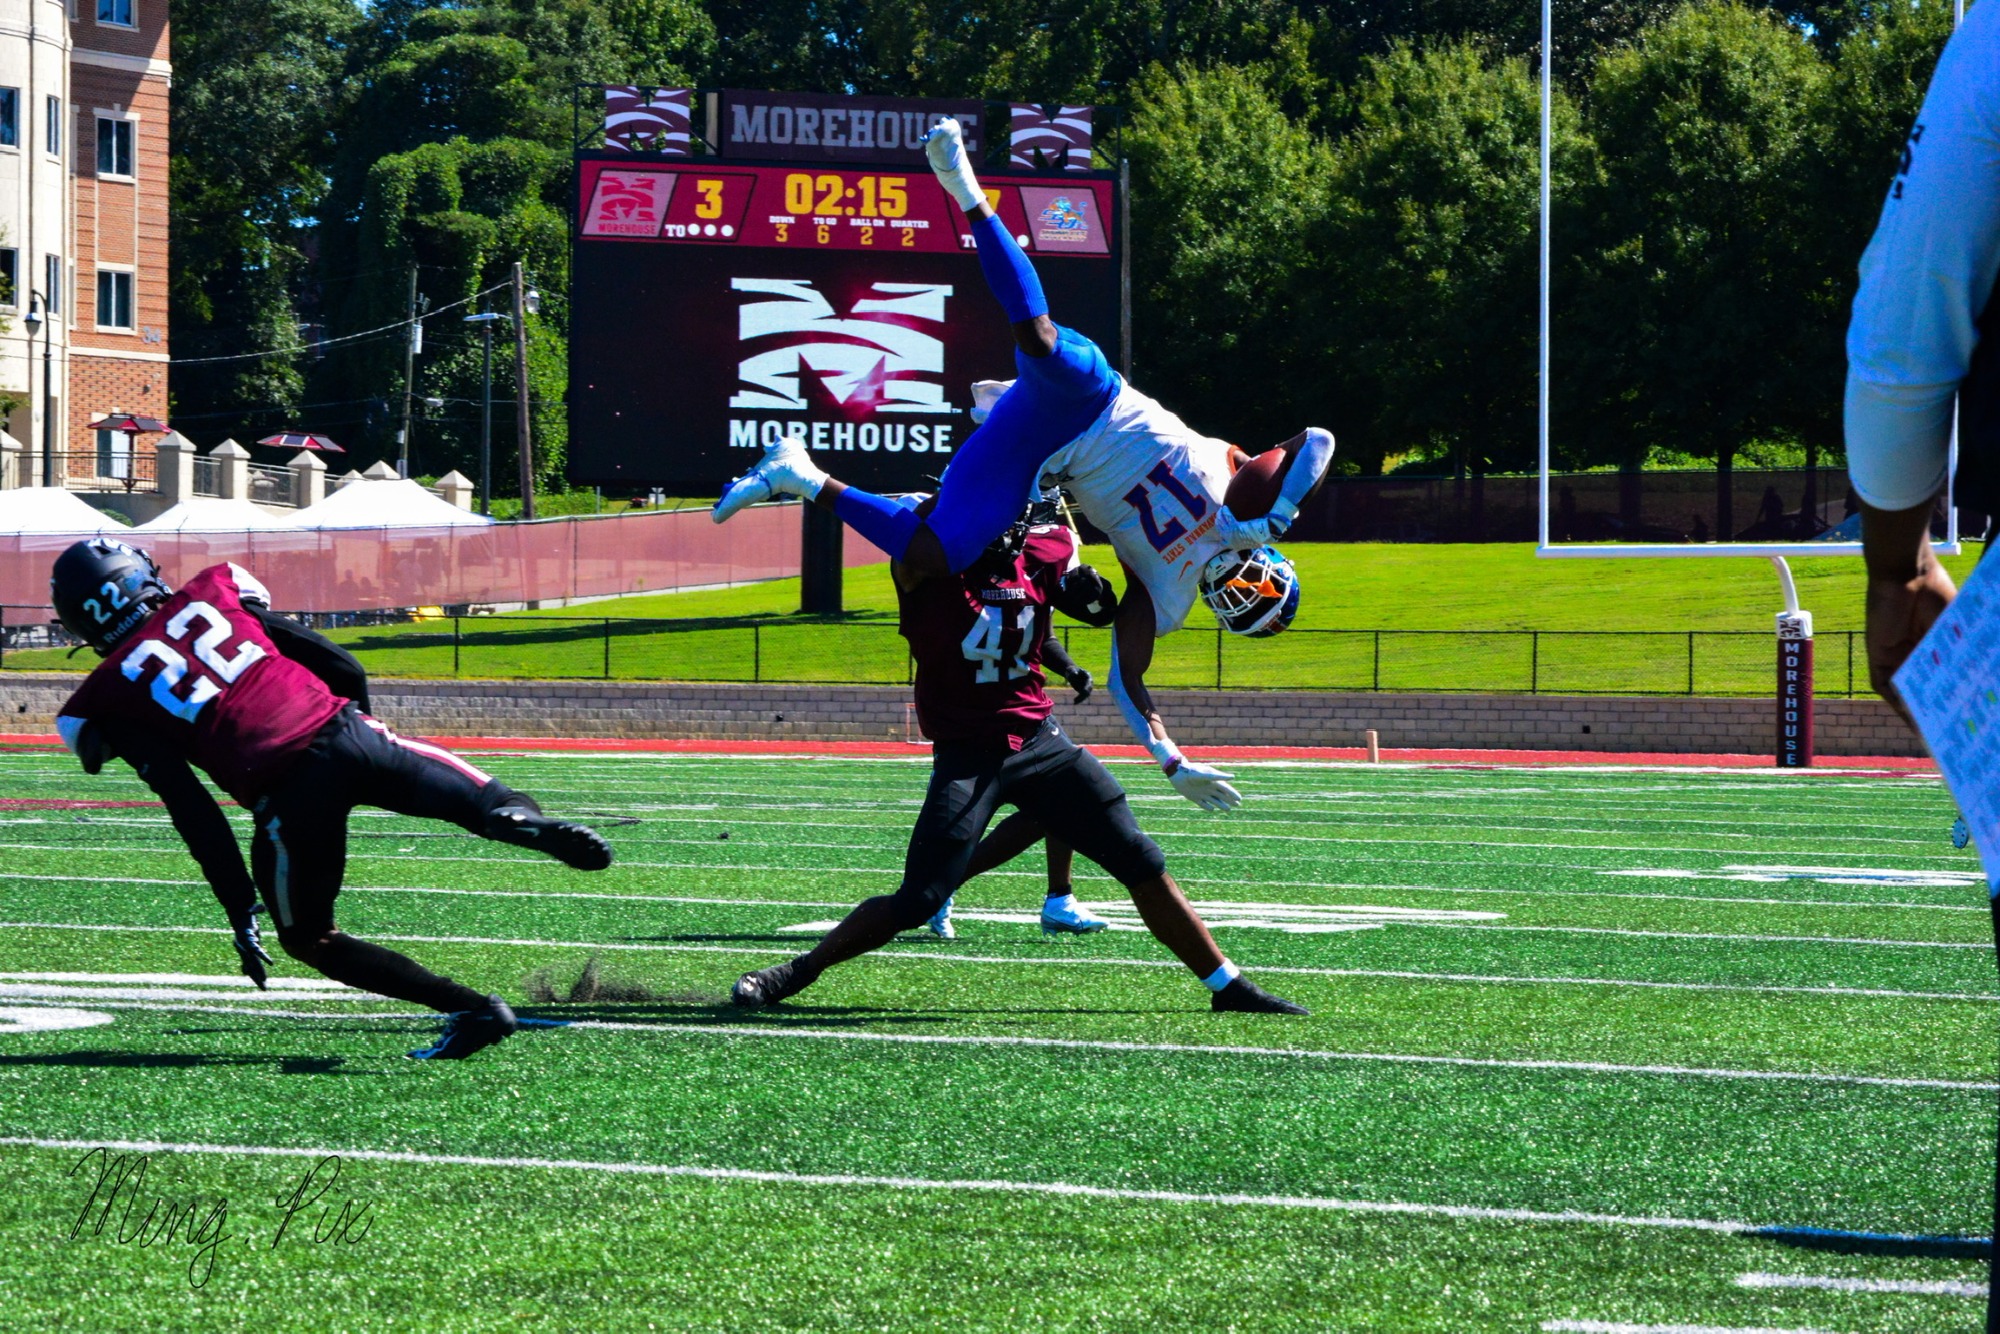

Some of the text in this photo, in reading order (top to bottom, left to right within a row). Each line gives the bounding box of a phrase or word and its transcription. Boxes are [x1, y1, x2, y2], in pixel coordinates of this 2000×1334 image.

[731, 104, 977, 151] MOREHOUE
[695, 179, 724, 219] 3
[785, 173, 908, 218] 02:15
[665, 224, 686, 237] TO
[775, 223, 788, 243] 3
[817, 224, 830, 244] 6
[860, 226, 873, 245] 2
[901, 227, 915, 247] 2
[729, 419, 953, 453] MOREHOUSE
[1122, 459, 1207, 555] 17
[83, 581, 130, 625] 22
[103, 601, 150, 645] Riddell
[120, 600, 267, 724] 22
[961, 604, 1035, 684] 41
[1785, 643, 1799, 765] MOREHOUSE
